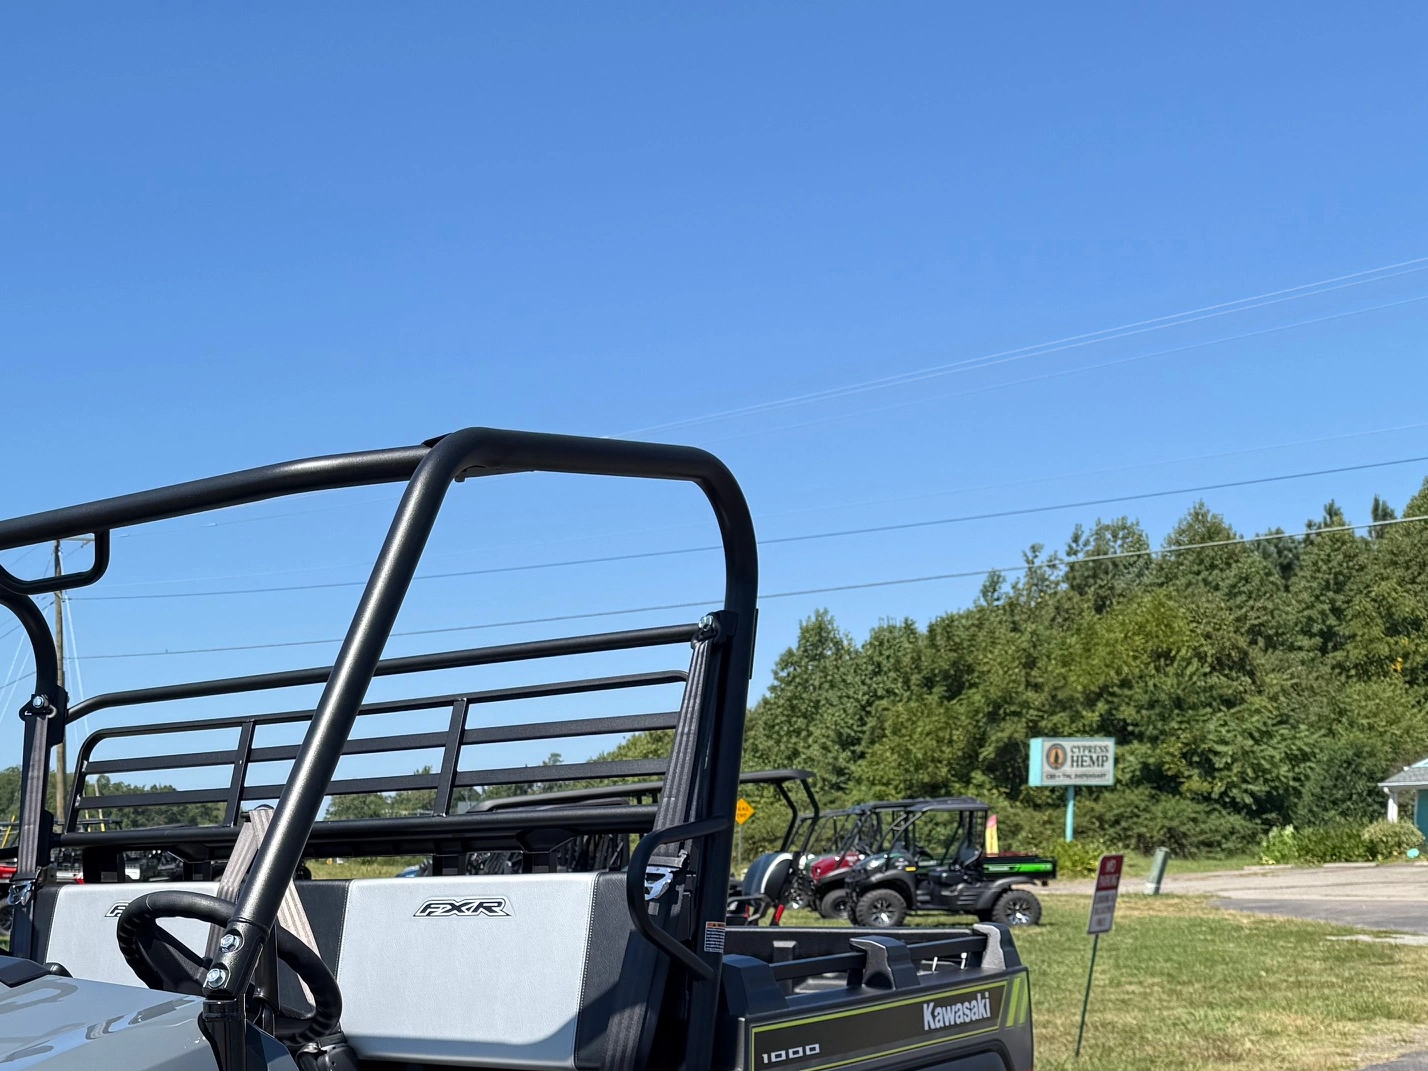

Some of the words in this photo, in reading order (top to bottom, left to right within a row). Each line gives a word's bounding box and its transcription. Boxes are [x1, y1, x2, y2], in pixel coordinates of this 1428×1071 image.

[1070, 745, 1109, 754] CYPRESS
[1070, 755, 1109, 768] HEMP
[413, 897, 512, 918] FXR
[923, 991, 991, 1030] Kawasaki
[762, 1044, 820, 1064] 1000
